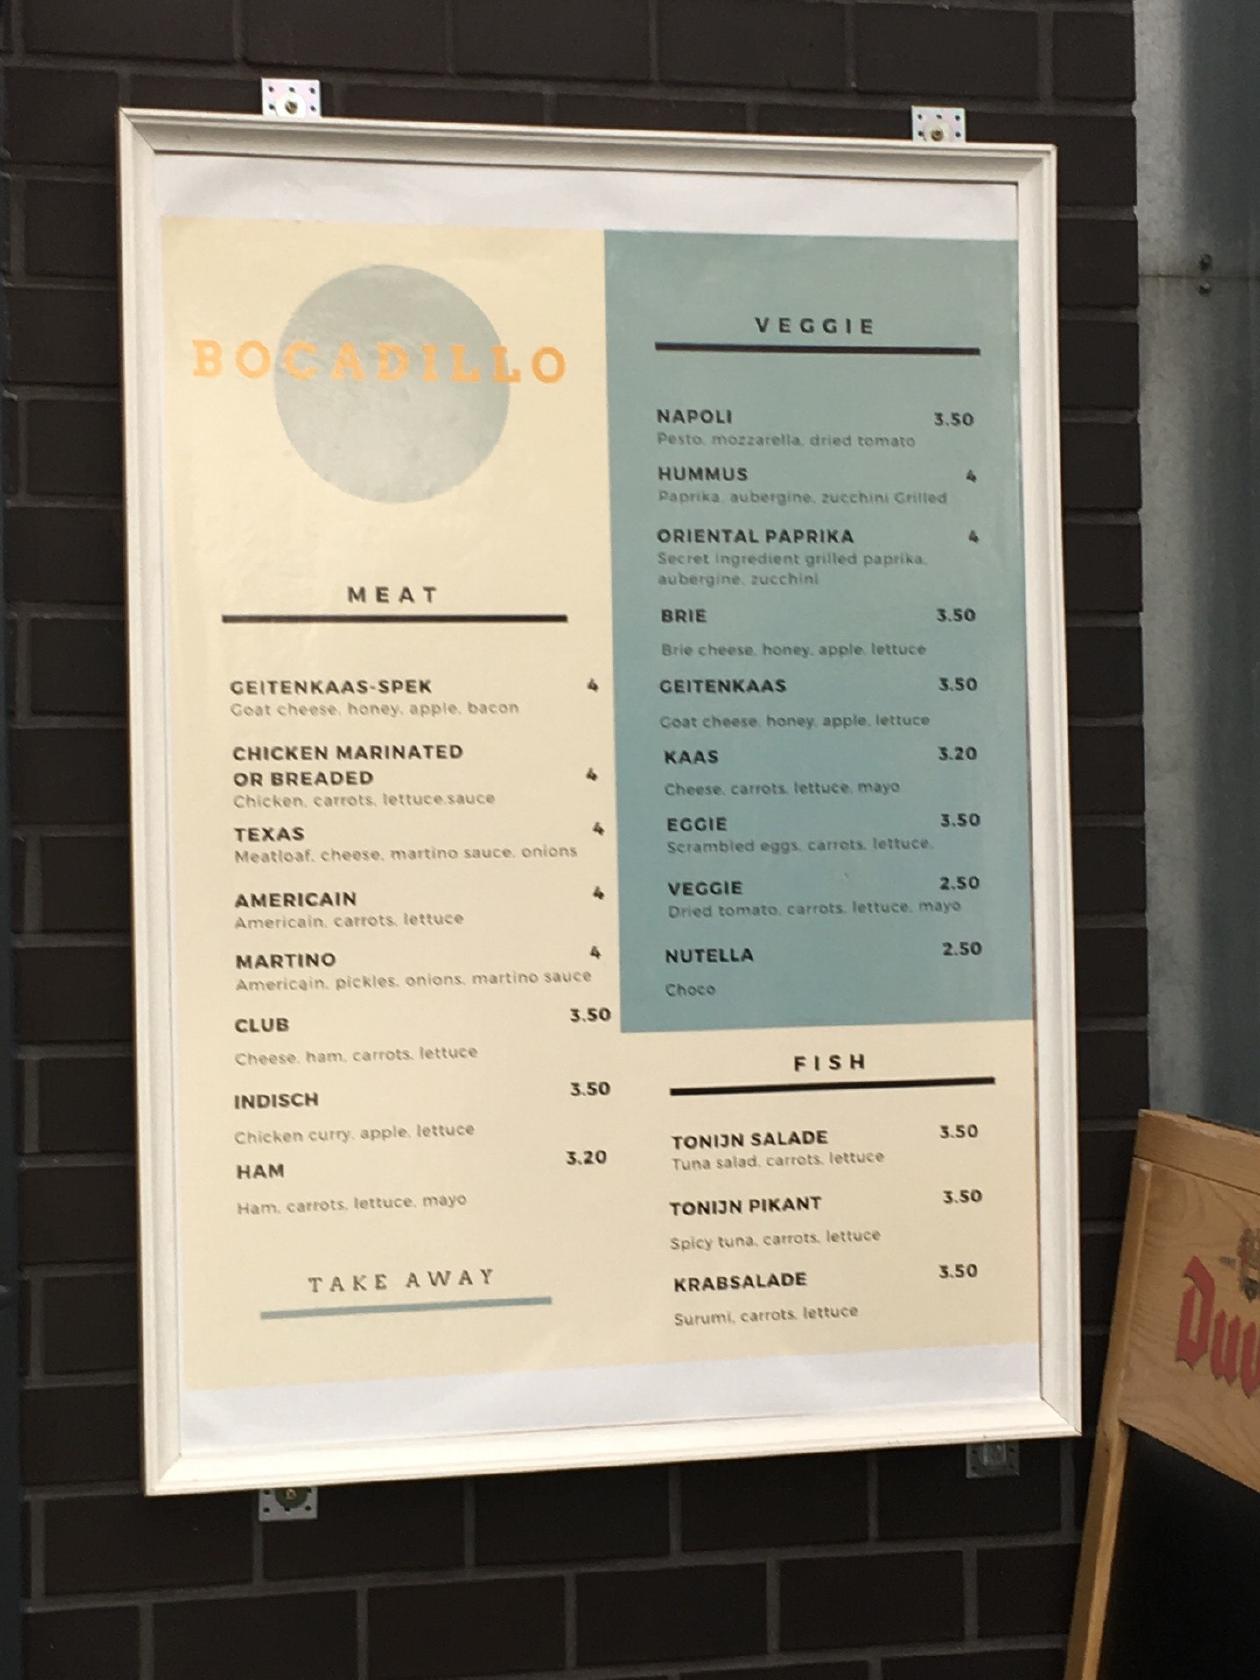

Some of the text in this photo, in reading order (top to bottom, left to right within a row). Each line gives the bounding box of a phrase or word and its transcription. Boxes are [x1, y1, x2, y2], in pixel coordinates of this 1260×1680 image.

[755, 317, 872, 334] VEGGIE
[193, 340, 567, 384] BOCADILLO
[657, 409, 731, 424] NAPOLI
[935, 412, 974, 426] 3.50
[810, 434, 851, 446] dried
[858, 436, 915, 447] tomato
[659, 467, 747, 481] HUMMUS
[966, 470, 976, 482] 4
[822, 491, 889, 504] zucchini
[894, 492, 947, 504] Grilled
[657, 529, 854, 543] ORIENTAL PAPRIKA
[969, 530, 979, 543] 4
[658, 552, 709, 564] Secret
[716, 553, 799, 568] ingredient
[805, 552, 857, 568] grilled
[752, 572, 818, 585] zucchini
[348, 587, 436, 603] MEAT
[662, 609, 706, 623] BRIE
[937, 608, 976, 622] 3.50
[662, 643, 693, 656] Brie
[872, 642, 926, 655] lettuce
[230, 680, 431, 695] GEITENKAAS-SPEK
[587, 679, 598, 691] 4
[660, 679, 786, 693] GEITENKAAS
[939, 677, 977, 691] 3.50
[468, 702, 519, 714] bacon
[876, 714, 930, 726] lettuce
[233, 745, 463, 761] CHICKEN MARINATED
[665, 750, 718, 764] KAAS
[939, 747, 977, 760] 3.20
[234, 771, 373, 787] OR BREADED
[586, 768, 597, 781] 4
[858, 783, 900, 795] mayo
[668, 817, 726, 831] EGGIE
[941, 813, 980, 827] 3.50
[235, 827, 304, 842] TEXAS
[593, 822, 604, 835] 4
[390, 848, 458, 860] martino
[522, 846, 577, 858] onions
[667, 840, 754, 854] Scrambled
[668, 881, 742, 896] VEGGIE
[940, 876, 979, 890] 2.50
[235, 892, 356, 908] AMERICAIN
[593, 887, 604, 900] 4
[669, 905, 712, 919] Dried
[919, 901, 961, 914] mayo
[404, 913, 464, 925] lettuce
[590, 946, 601, 959] 4
[666, 948, 753, 963] NUTELLA
[943, 942, 982, 956] 2.50
[236, 953, 335, 969] MARTINO
[472, 972, 538, 984] martino
[544, 971, 591, 983] sauce
[666, 984, 716, 997] Choco
[571, 1008, 611, 1022] 3.50
[235, 1018, 289, 1033] CLUB
[420, 1047, 478, 1059] lettuce
[795, 1054, 864, 1071] FISH
[571, 1082, 610, 1096] 3.50
[235, 1093, 318, 1109] INDISCH
[235, 1131, 303, 1144] Chicken
[417, 1124, 474, 1137] lettuce
[941, 1124, 978, 1138] 3.50
[672, 1130, 828, 1149] TONIJN SALADE
[567, 1150, 606, 1165] 3.20
[672, 1158, 710, 1170] Tuna
[830, 1152, 884, 1164] lettuce
[237, 1164, 284, 1179] HAM
[423, 1195, 467, 1208] mayo
[944, 1190, 982, 1204] 3.50
[670, 1196, 821, 1216] TONIJN PIKANT
[671, 1237, 712, 1251] Spicy
[827, 1230, 880, 1242] lettuce
[940, 1264, 977, 1278] 3.50
[308, 1269, 492, 1293] TAKE AWAY
[675, 1272, 806, 1292] KRABSALADE
[803, 1307, 858, 1319] lettuce
